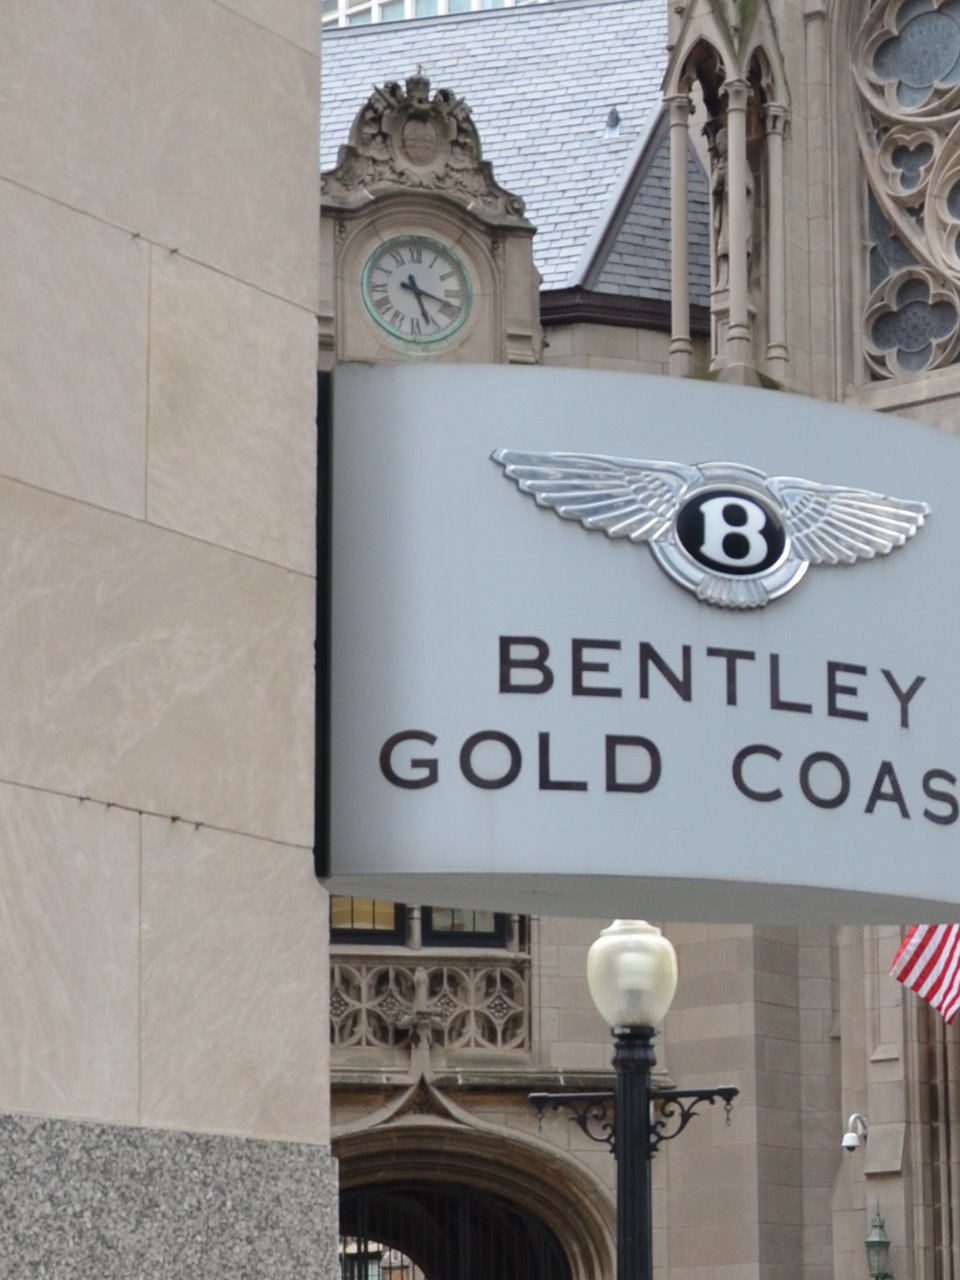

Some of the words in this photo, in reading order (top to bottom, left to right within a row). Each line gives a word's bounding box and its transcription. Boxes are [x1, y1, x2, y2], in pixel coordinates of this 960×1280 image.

[698, 496, 768, 568] B
[498, 635, 927, 728] BENTLEY
[379, 729, 662, 793] GOLD
